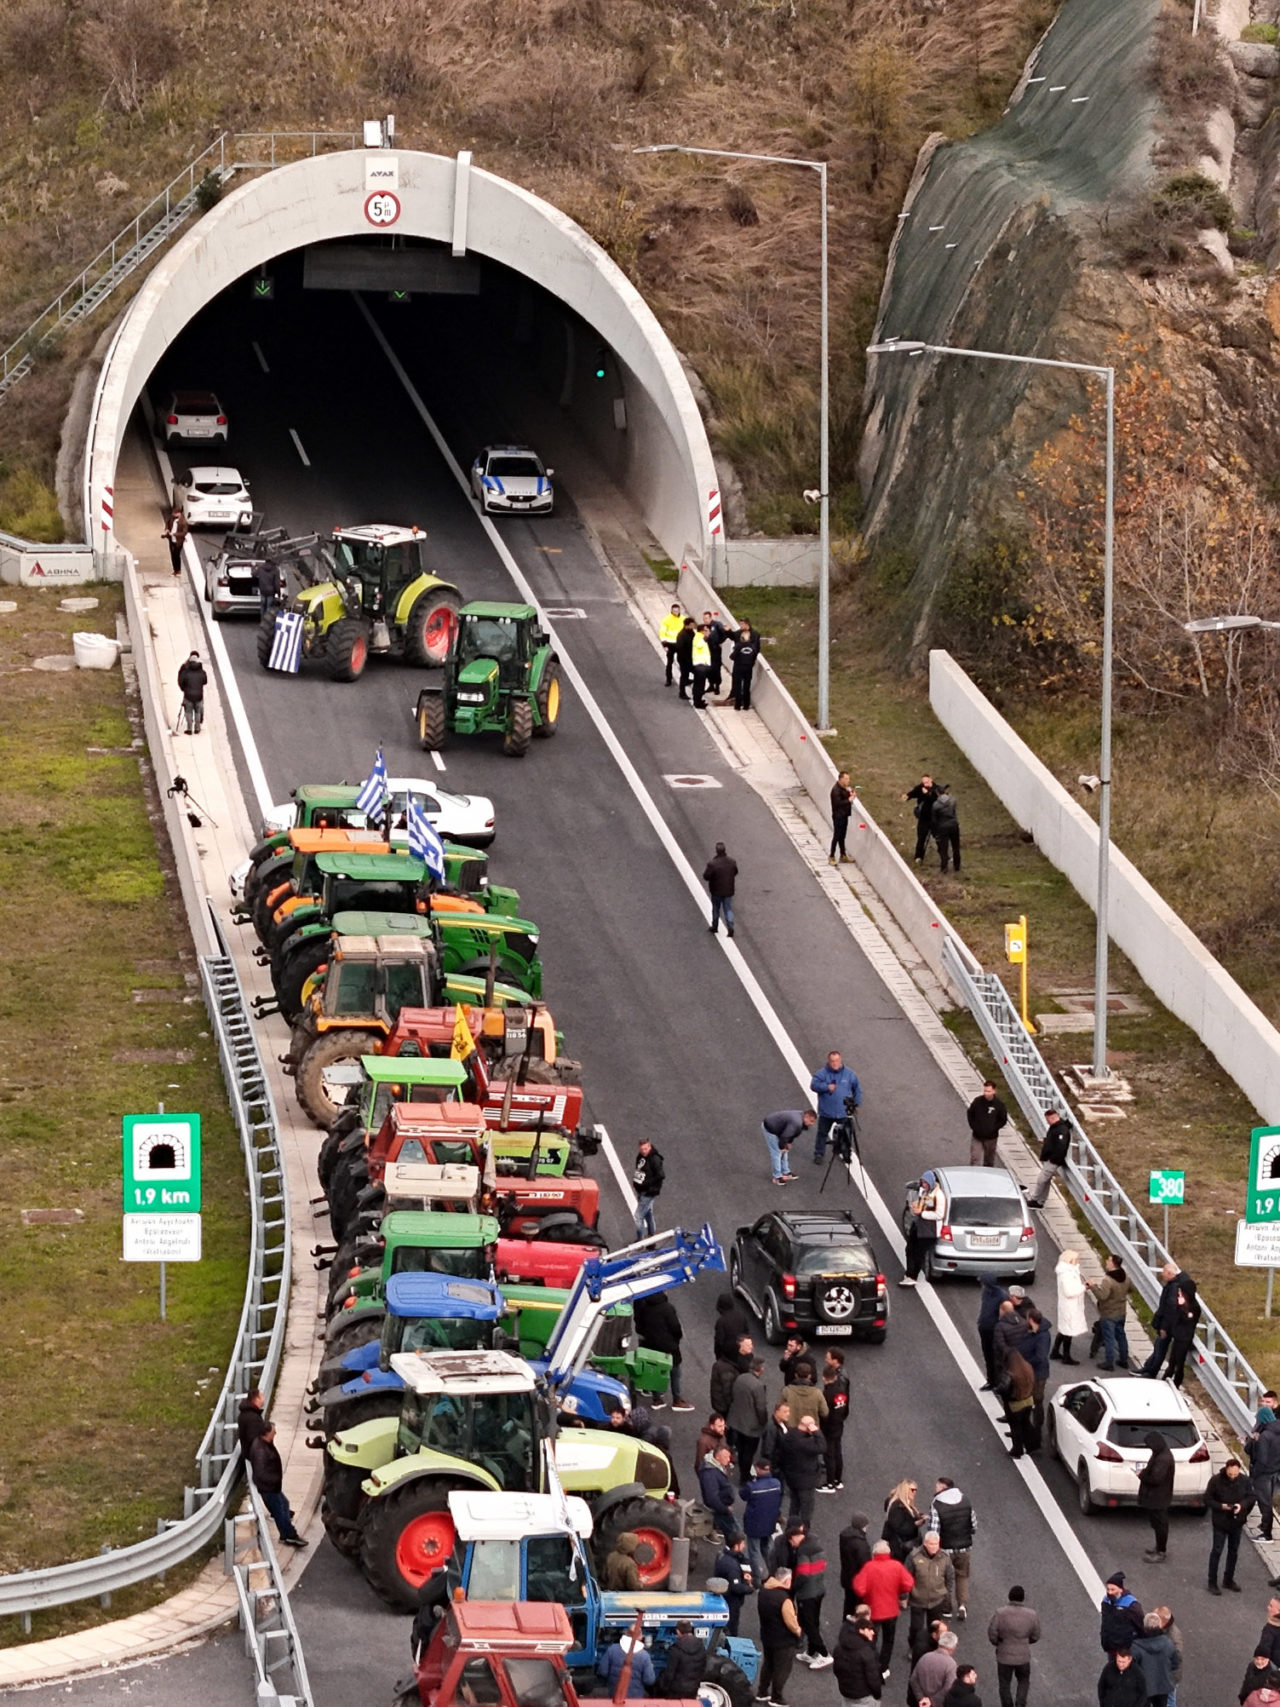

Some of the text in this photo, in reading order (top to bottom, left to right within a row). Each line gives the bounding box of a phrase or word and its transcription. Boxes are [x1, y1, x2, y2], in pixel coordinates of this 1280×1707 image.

[374, 201, 382, 217] 5
[1158, 1177, 1185, 1198] 380
[161, 1188, 190, 1204] km
